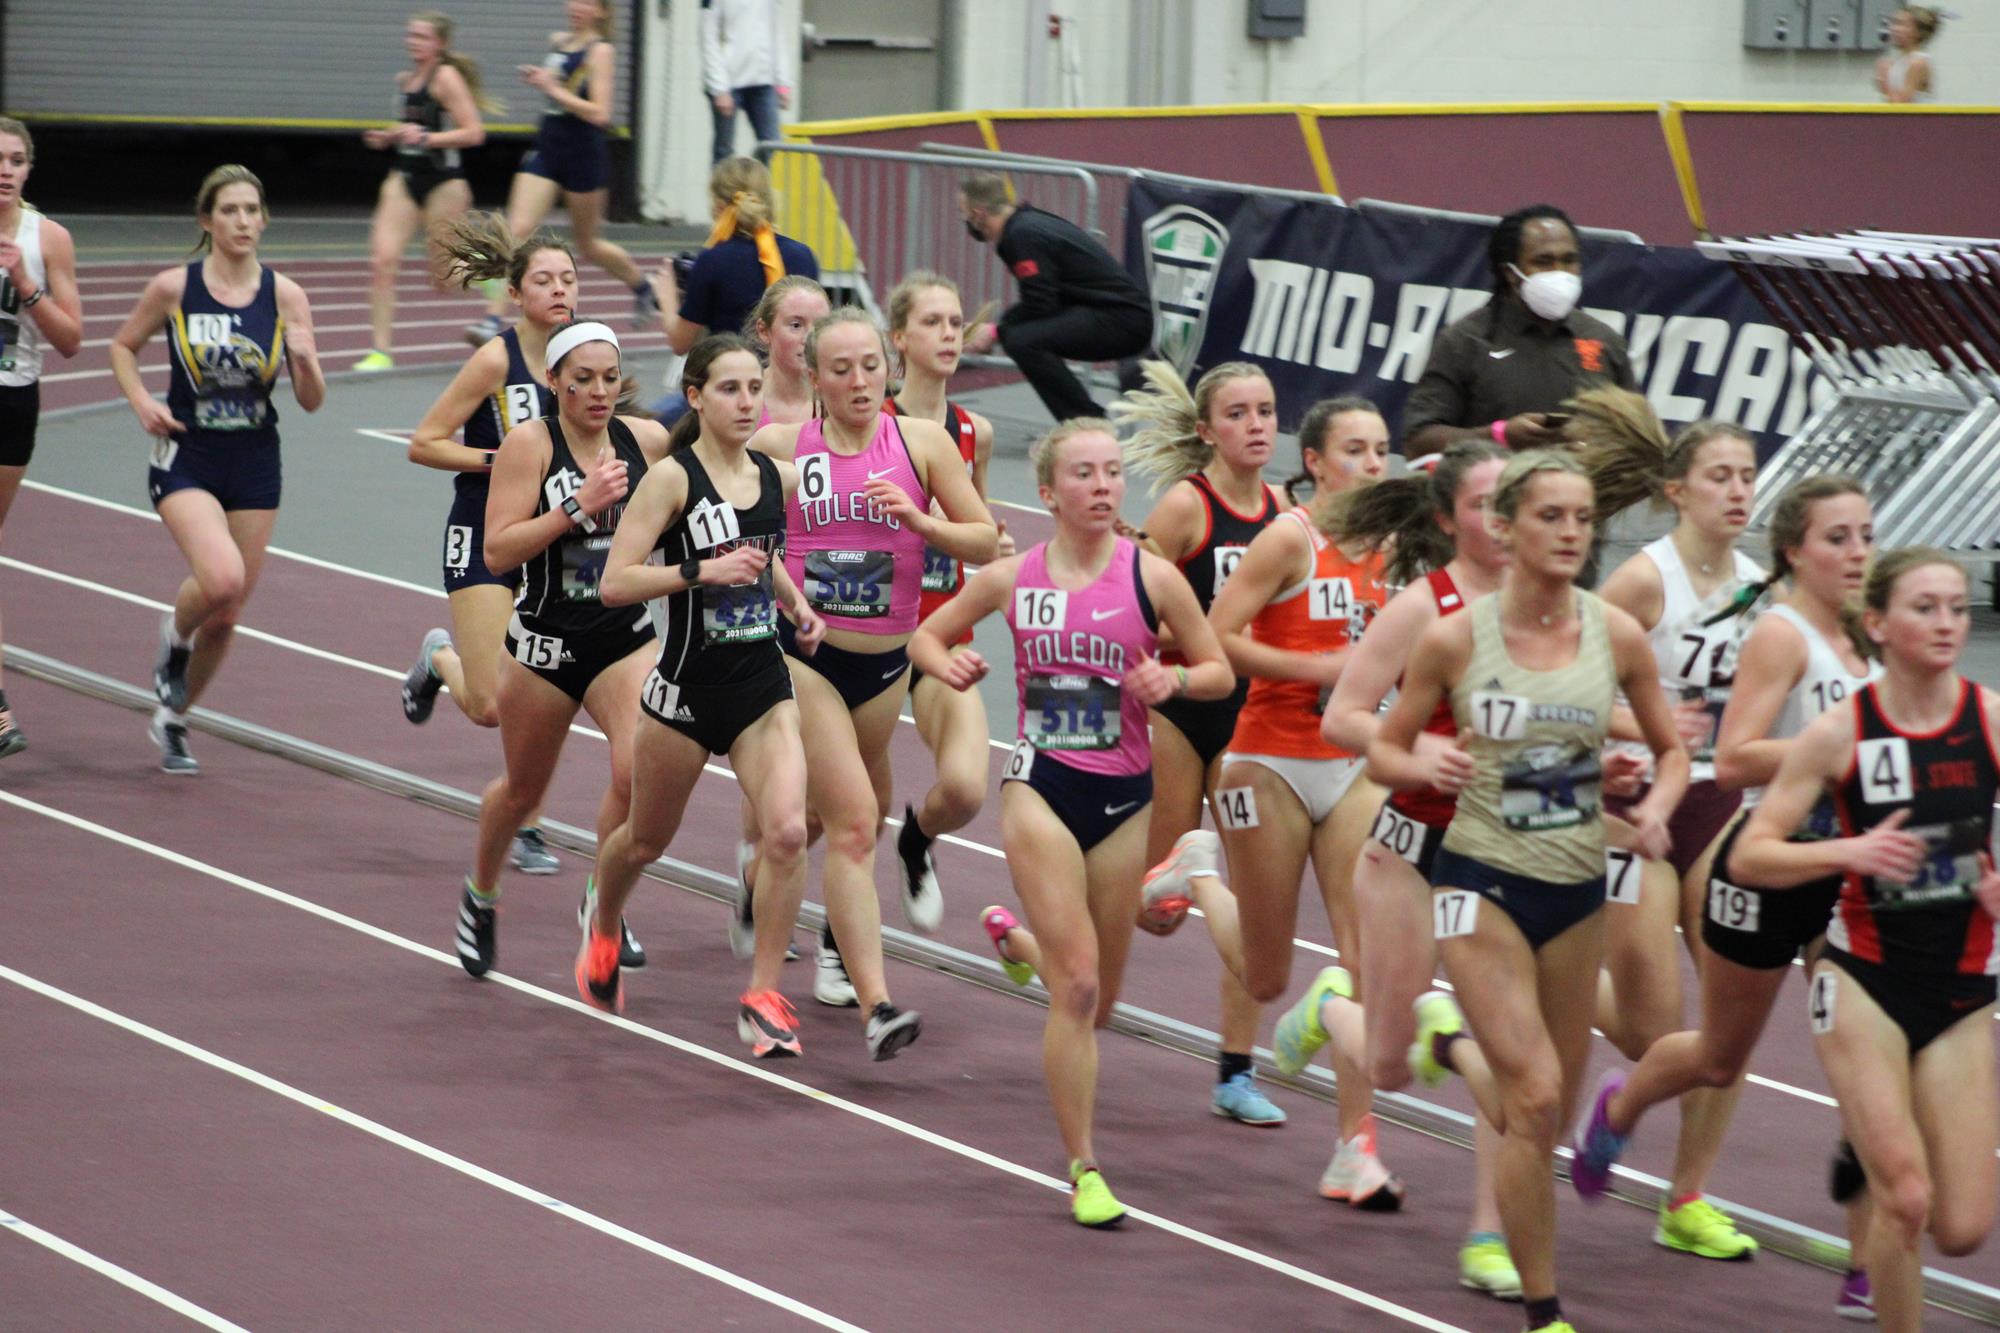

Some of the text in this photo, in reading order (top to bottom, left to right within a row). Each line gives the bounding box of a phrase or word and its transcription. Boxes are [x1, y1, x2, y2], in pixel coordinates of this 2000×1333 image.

[1239, 257, 1842, 438] MID-AICA
[514, 386, 532, 424] 3
[803, 456, 825, 499] 6
[696, 507, 730, 544] 11
[450, 528, 466, 565] 3
[822, 602, 871, 613] 2021INDOOR
[1023, 591, 1056, 626] 16
[1318, 581, 1348, 617] 14
[525, 634, 555, 667] 15
[1022, 631, 1126, 674] TOLEDO
[1679, 633, 1706, 679] 7
[649, 675, 669, 713] 11
[1480, 698, 1516, 738] 17
[1872, 744, 1900, 796] 4
[1221, 791, 1250, 828] 14
[1380, 812, 1414, 855] 20
[1609, 851, 1634, 898] 7
[1438, 895, 1467, 934] 17
[1716, 886, 1748, 926] 19
[1812, 976, 1828, 1028] 4
